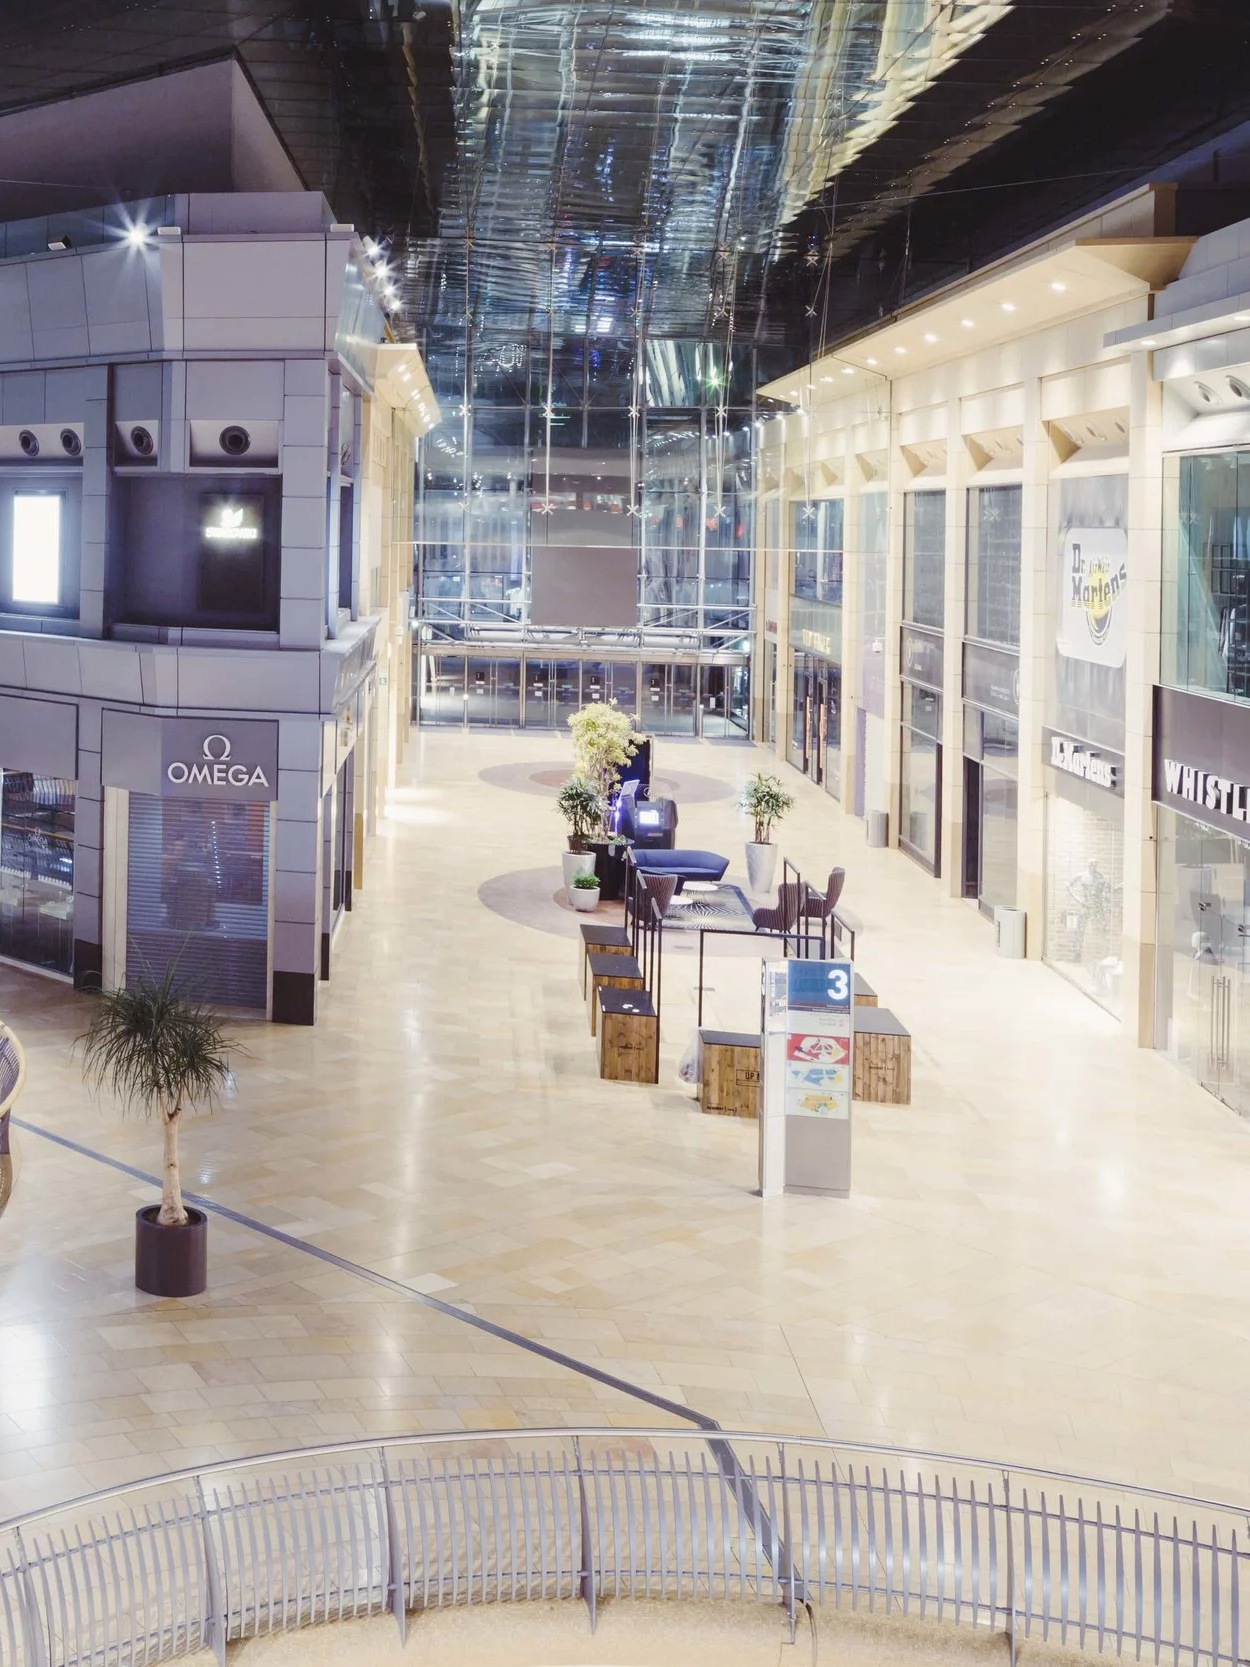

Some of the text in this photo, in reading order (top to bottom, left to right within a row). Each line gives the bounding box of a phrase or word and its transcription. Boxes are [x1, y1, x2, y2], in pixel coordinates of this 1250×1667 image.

[1071, 562, 1127, 602] Martens
[167, 762, 269, 787] OMEGA
[827, 969, 848, 1000] 3
